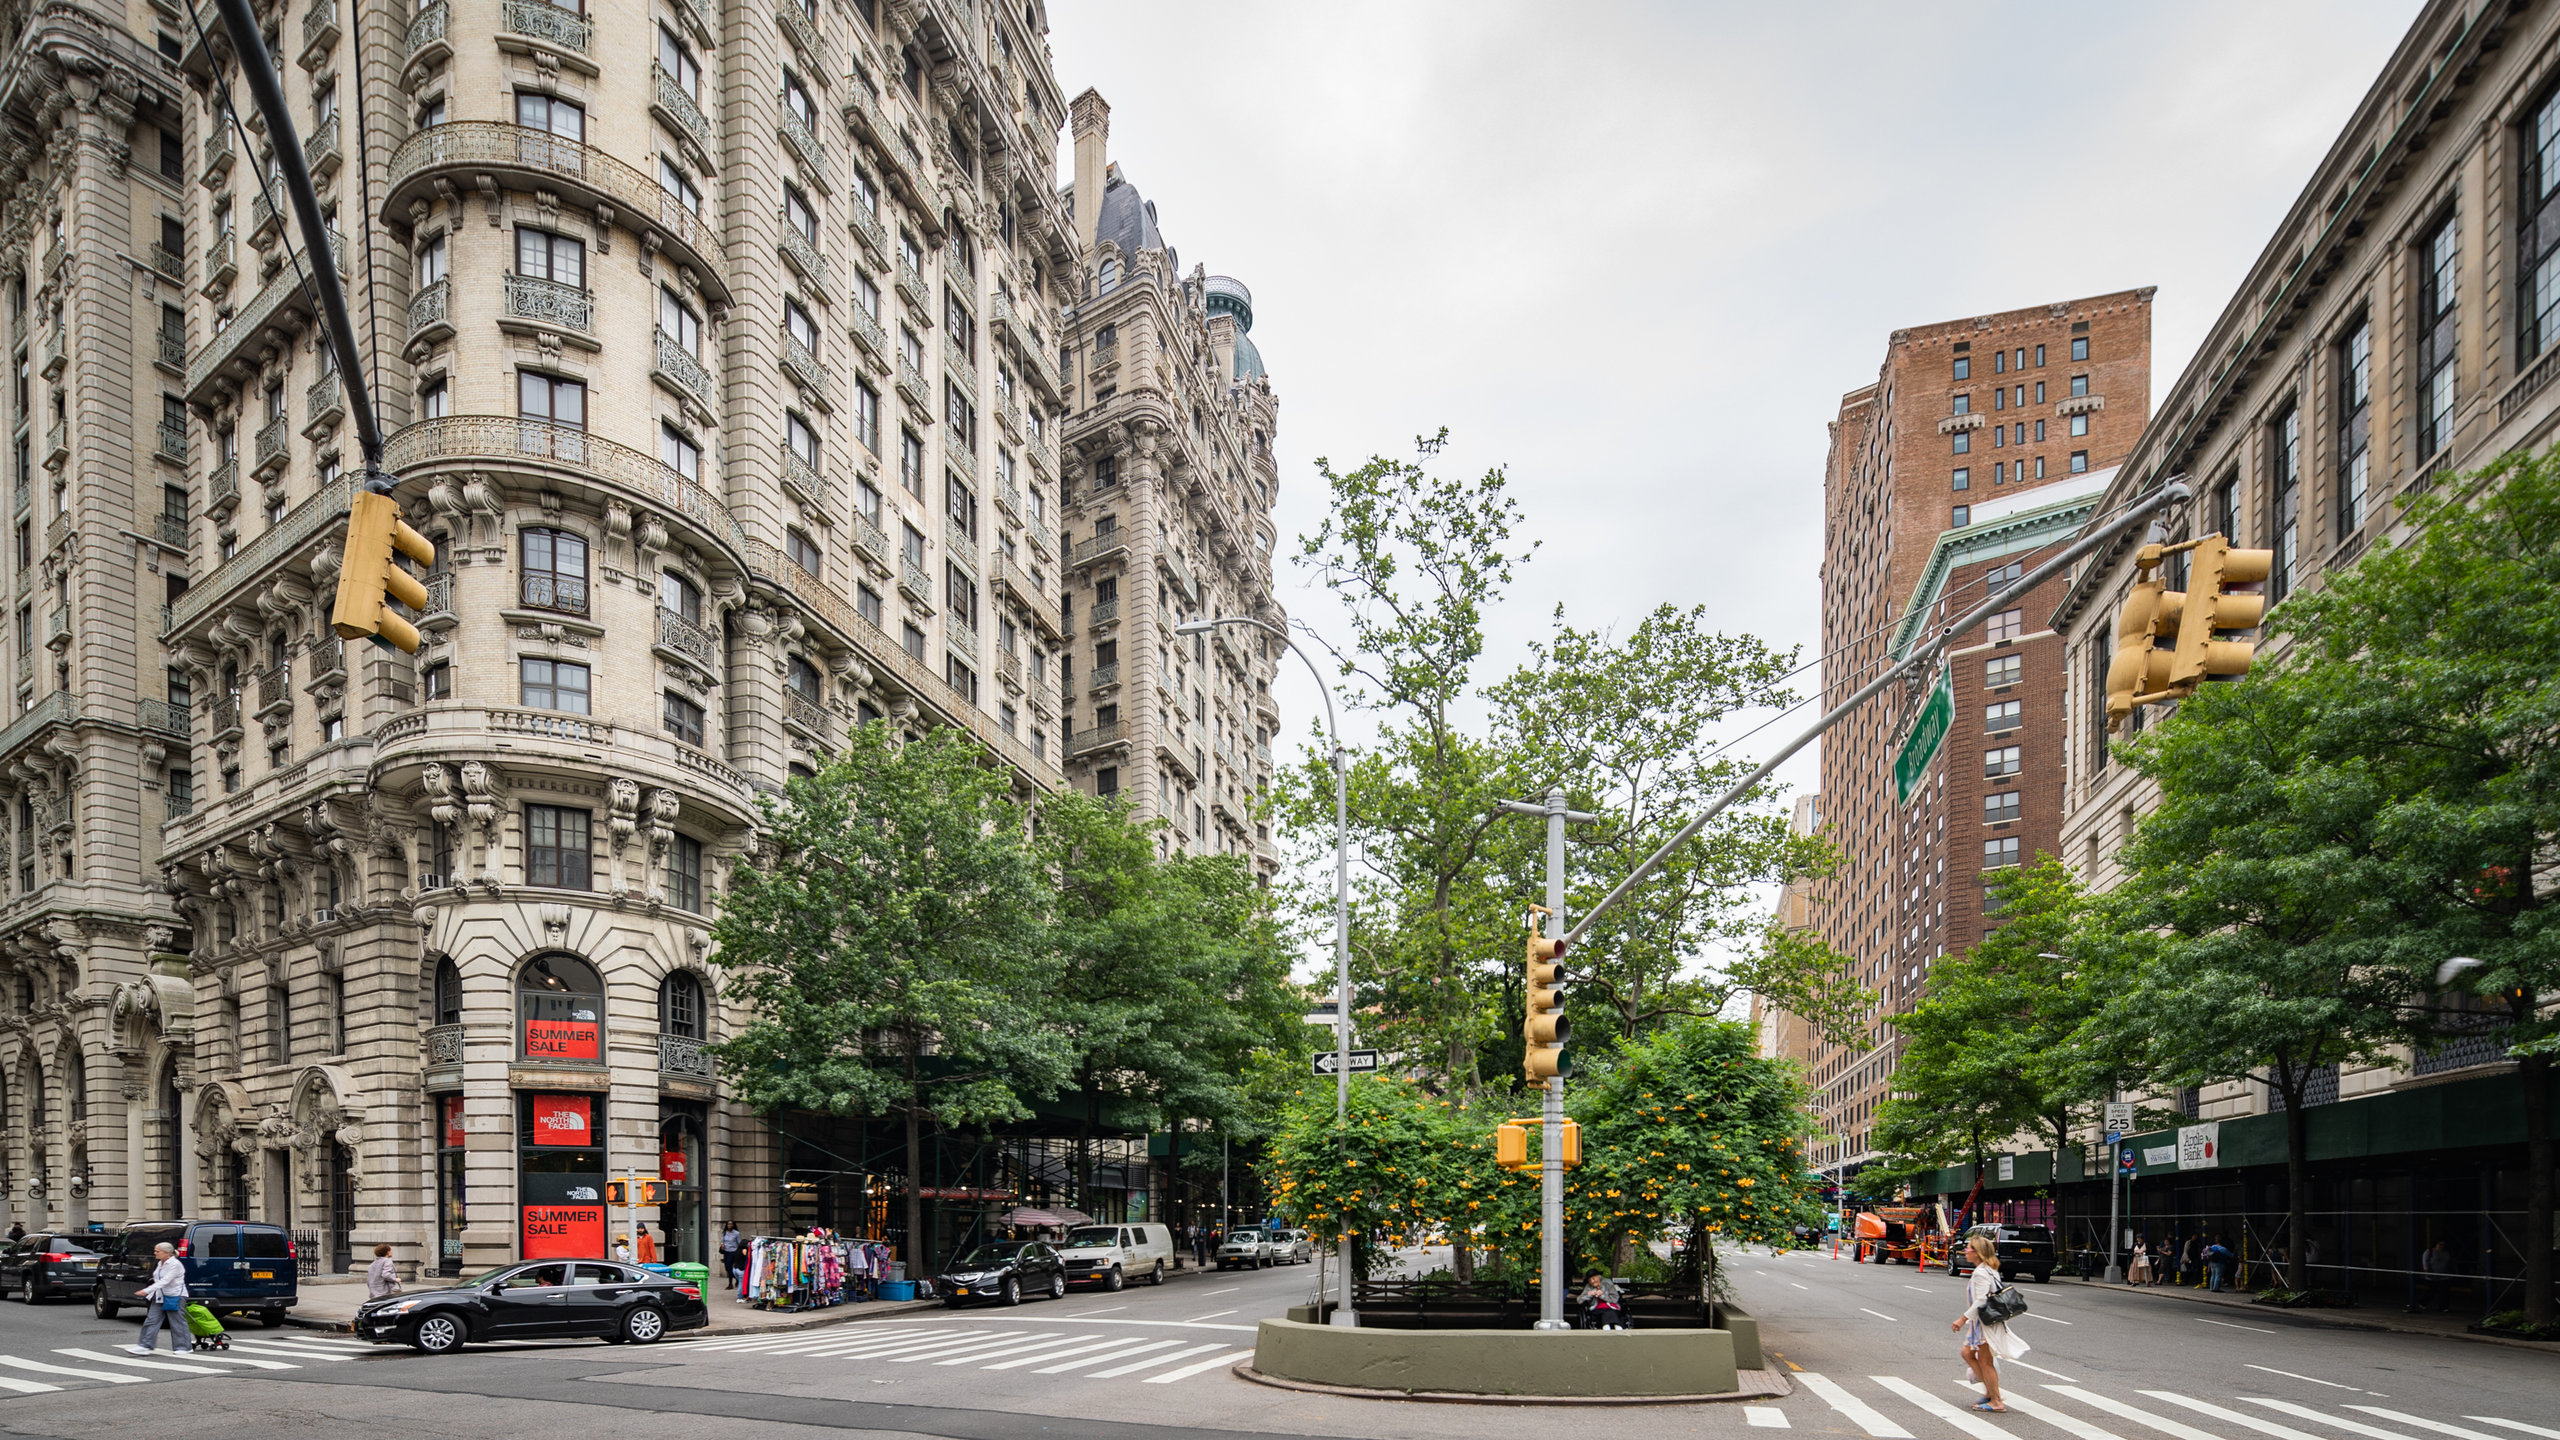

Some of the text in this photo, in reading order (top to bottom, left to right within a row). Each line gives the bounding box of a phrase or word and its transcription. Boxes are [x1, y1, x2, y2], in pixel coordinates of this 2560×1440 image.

[1908, 706, 1940, 777] Broadway
[529, 1029, 595, 1041] SUMMER
[530, 1041, 567, 1052] SALE
[1349, 1057, 1368, 1066] WAY
[2108, 1119, 2129, 1129] 25
[2184, 1132, 2204, 1149] Apple
[2184, 1147, 2202, 1161] Bank
[528, 1211, 597, 1222] SUMMER
[528, 1224, 567, 1235] SALE
